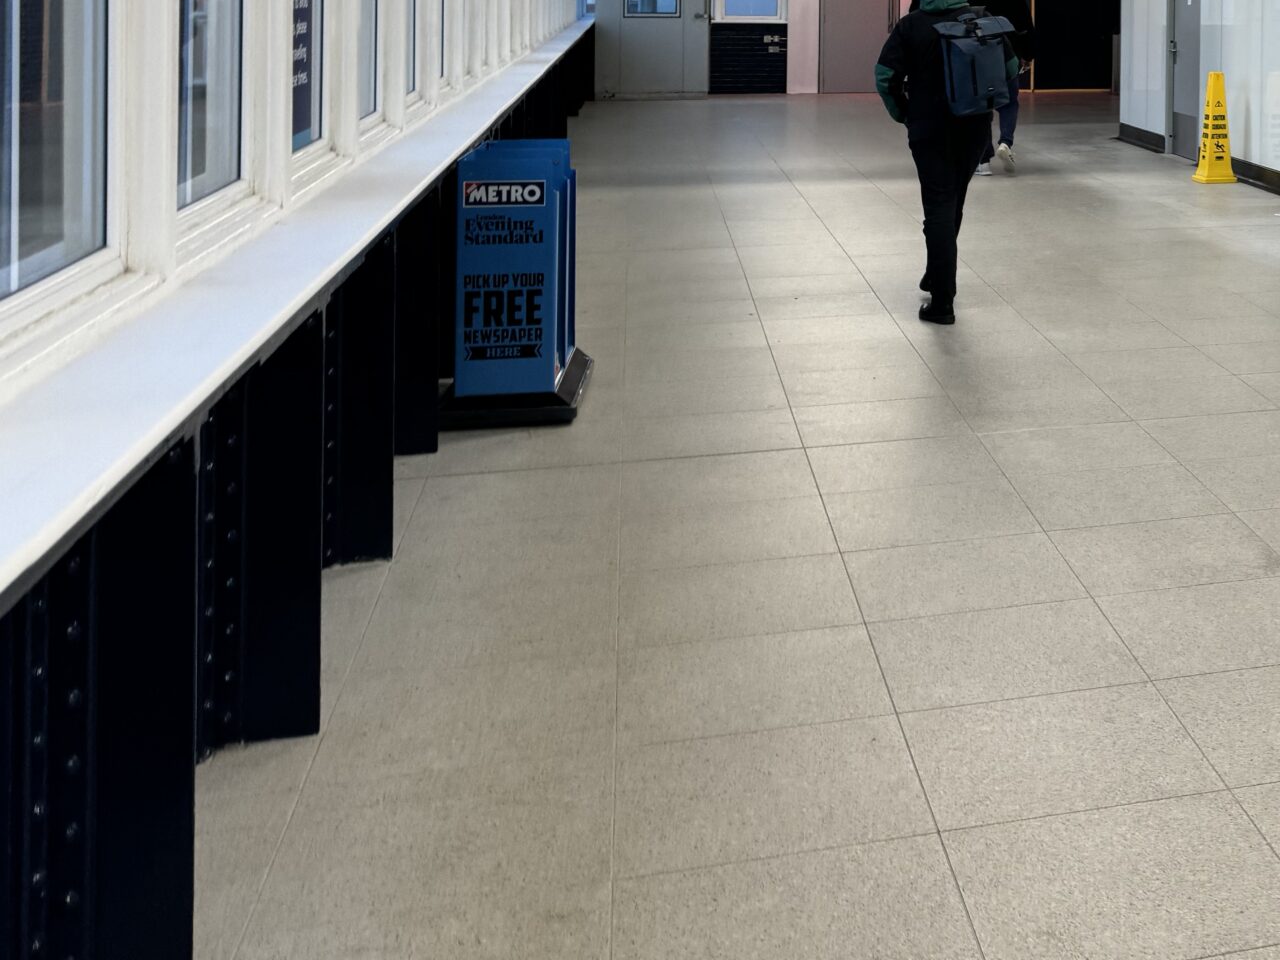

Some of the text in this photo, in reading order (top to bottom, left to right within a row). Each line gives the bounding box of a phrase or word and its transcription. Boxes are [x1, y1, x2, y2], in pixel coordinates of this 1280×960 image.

[467, 183, 541, 203] METRO
[464, 217, 534, 233] Evening
[464, 229, 544, 246] Standard
[463, 272, 545, 289] PICK UP YOUR
[463, 288, 543, 328] FREE
[463, 327, 543, 345] NEWSPAPER
[486, 346, 521, 357] HERE
